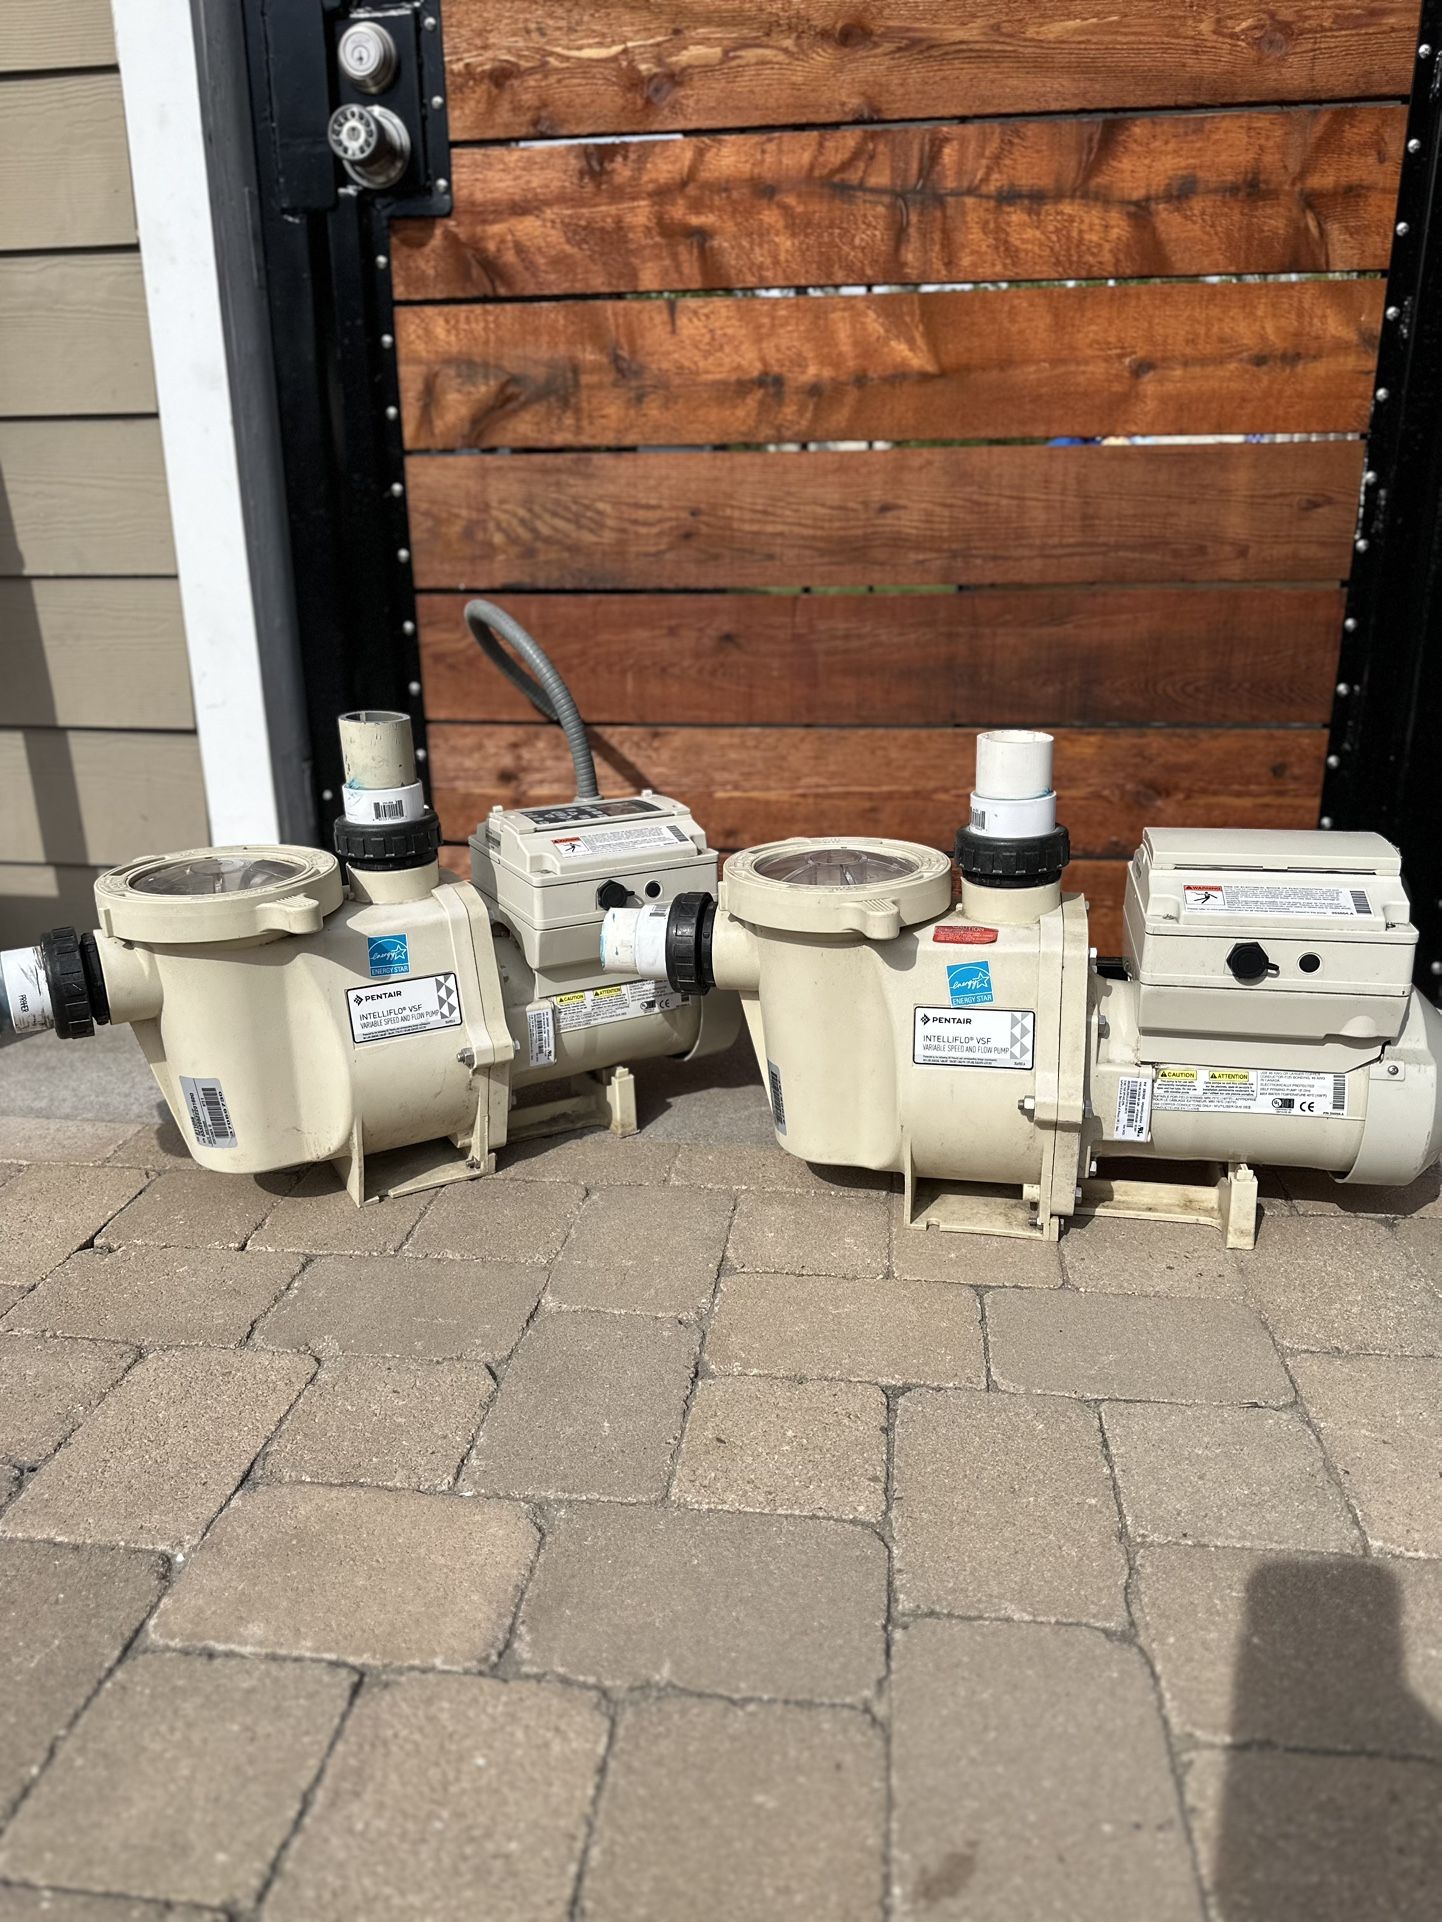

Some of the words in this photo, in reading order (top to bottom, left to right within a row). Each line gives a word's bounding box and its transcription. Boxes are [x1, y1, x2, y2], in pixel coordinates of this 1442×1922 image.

[371, 967, 393, 976] ENERGY
[394, 965, 409, 973] STAR
[365, 990, 402, 1002] PENTAIR
[563, 994, 584, 1002] CAUTION
[952, 996, 976, 1005] ENERGY
[976, 994, 992, 1002] STAR
[408, 1003, 423, 1013] VSF
[360, 1018, 383, 1030] VARIABLE
[384, 1016, 400, 1026] SPEED
[400, 1014, 411, 1023] AND
[411, 1012, 425, 1021] FLOW
[425, 1009, 440, 1018] PUMP
[932, 1016, 972, 1025] PENTAIR
[976, 1037, 992, 1045] VSF
[922, 1043, 946, 1053] VARIABLE
[947, 1044, 964, 1053] SPEED
[965, 1045, 977, 1054] AND
[977, 1045, 993, 1054] FLOW
[993, 1046, 1010, 1055] PUMP
